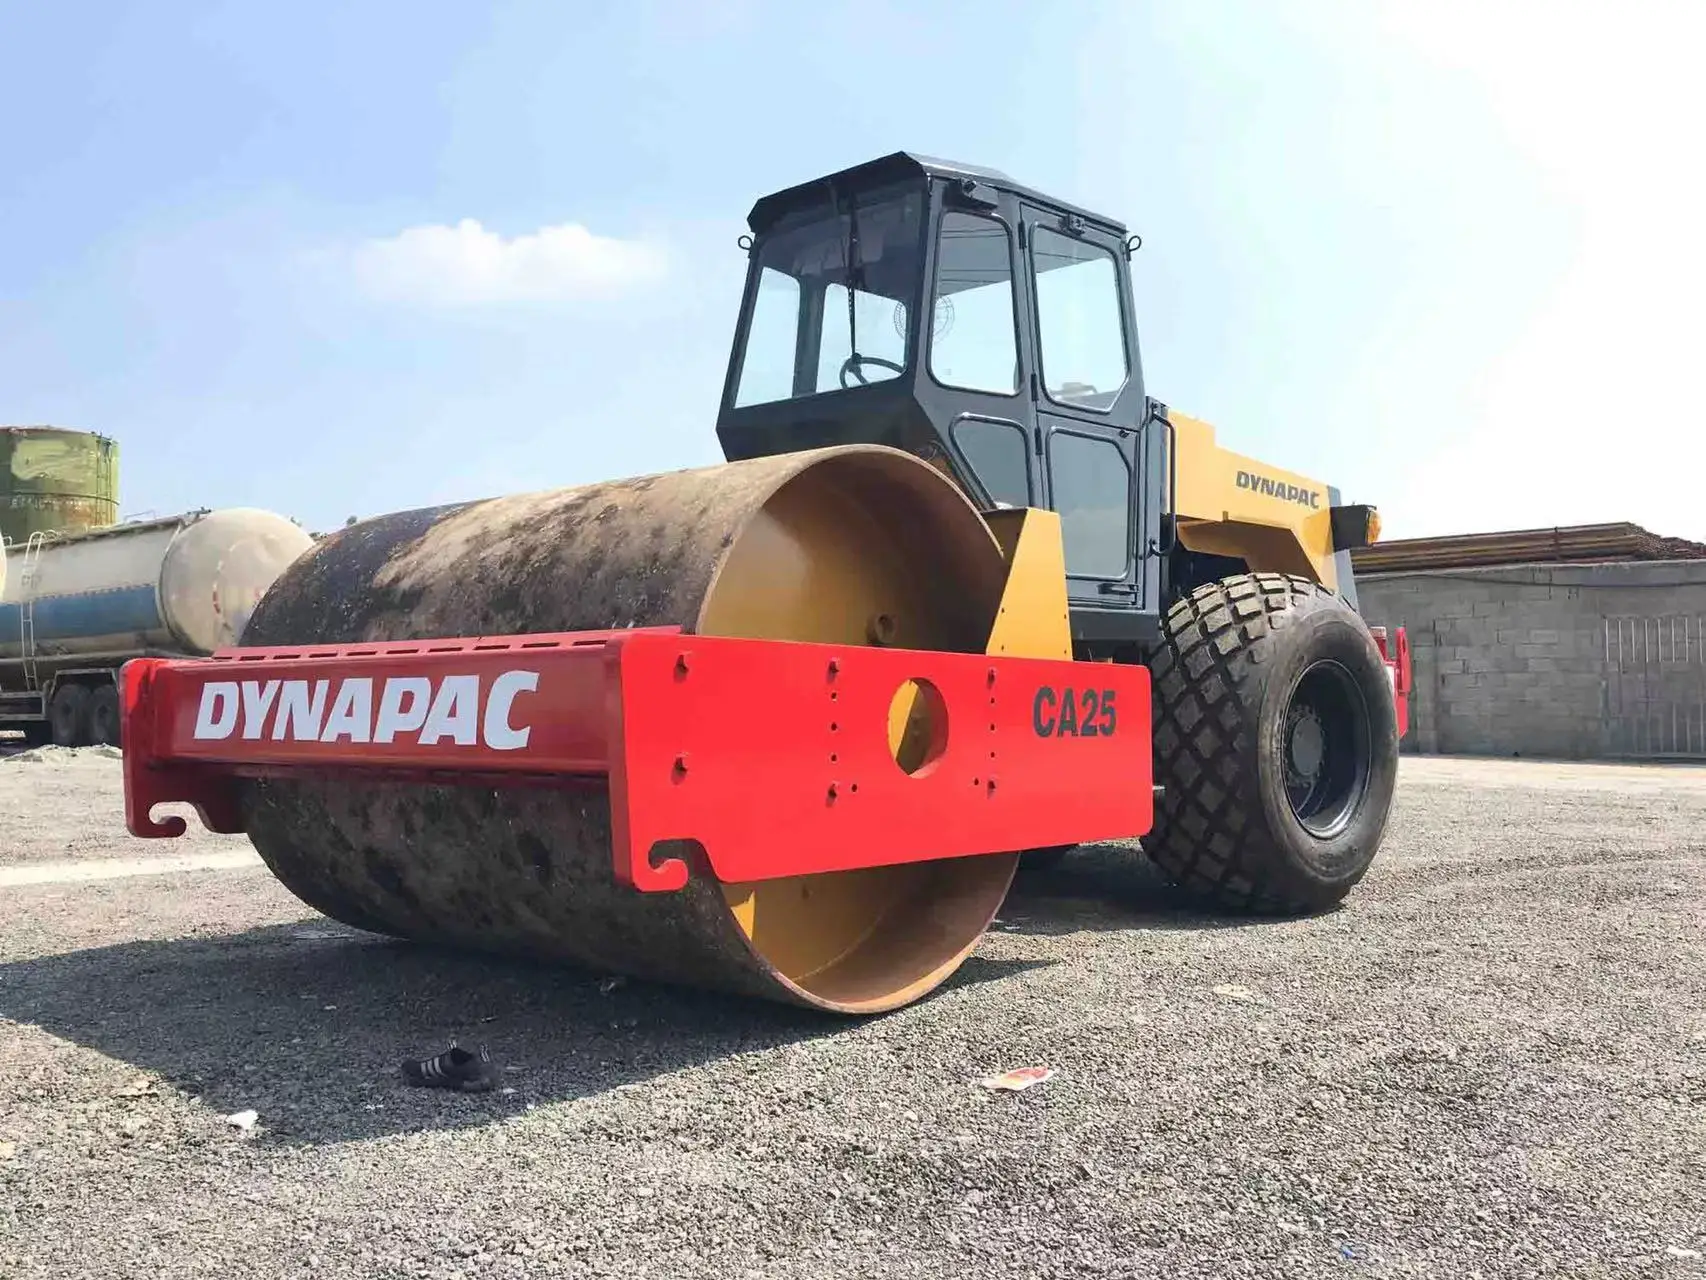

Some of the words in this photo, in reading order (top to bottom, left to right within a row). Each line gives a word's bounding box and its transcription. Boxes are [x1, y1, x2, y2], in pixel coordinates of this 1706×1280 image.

[1236, 471, 1319, 509] DYNAPAC
[194, 670, 540, 750] DYNAPAC
[1033, 685, 1117, 738] CA25
